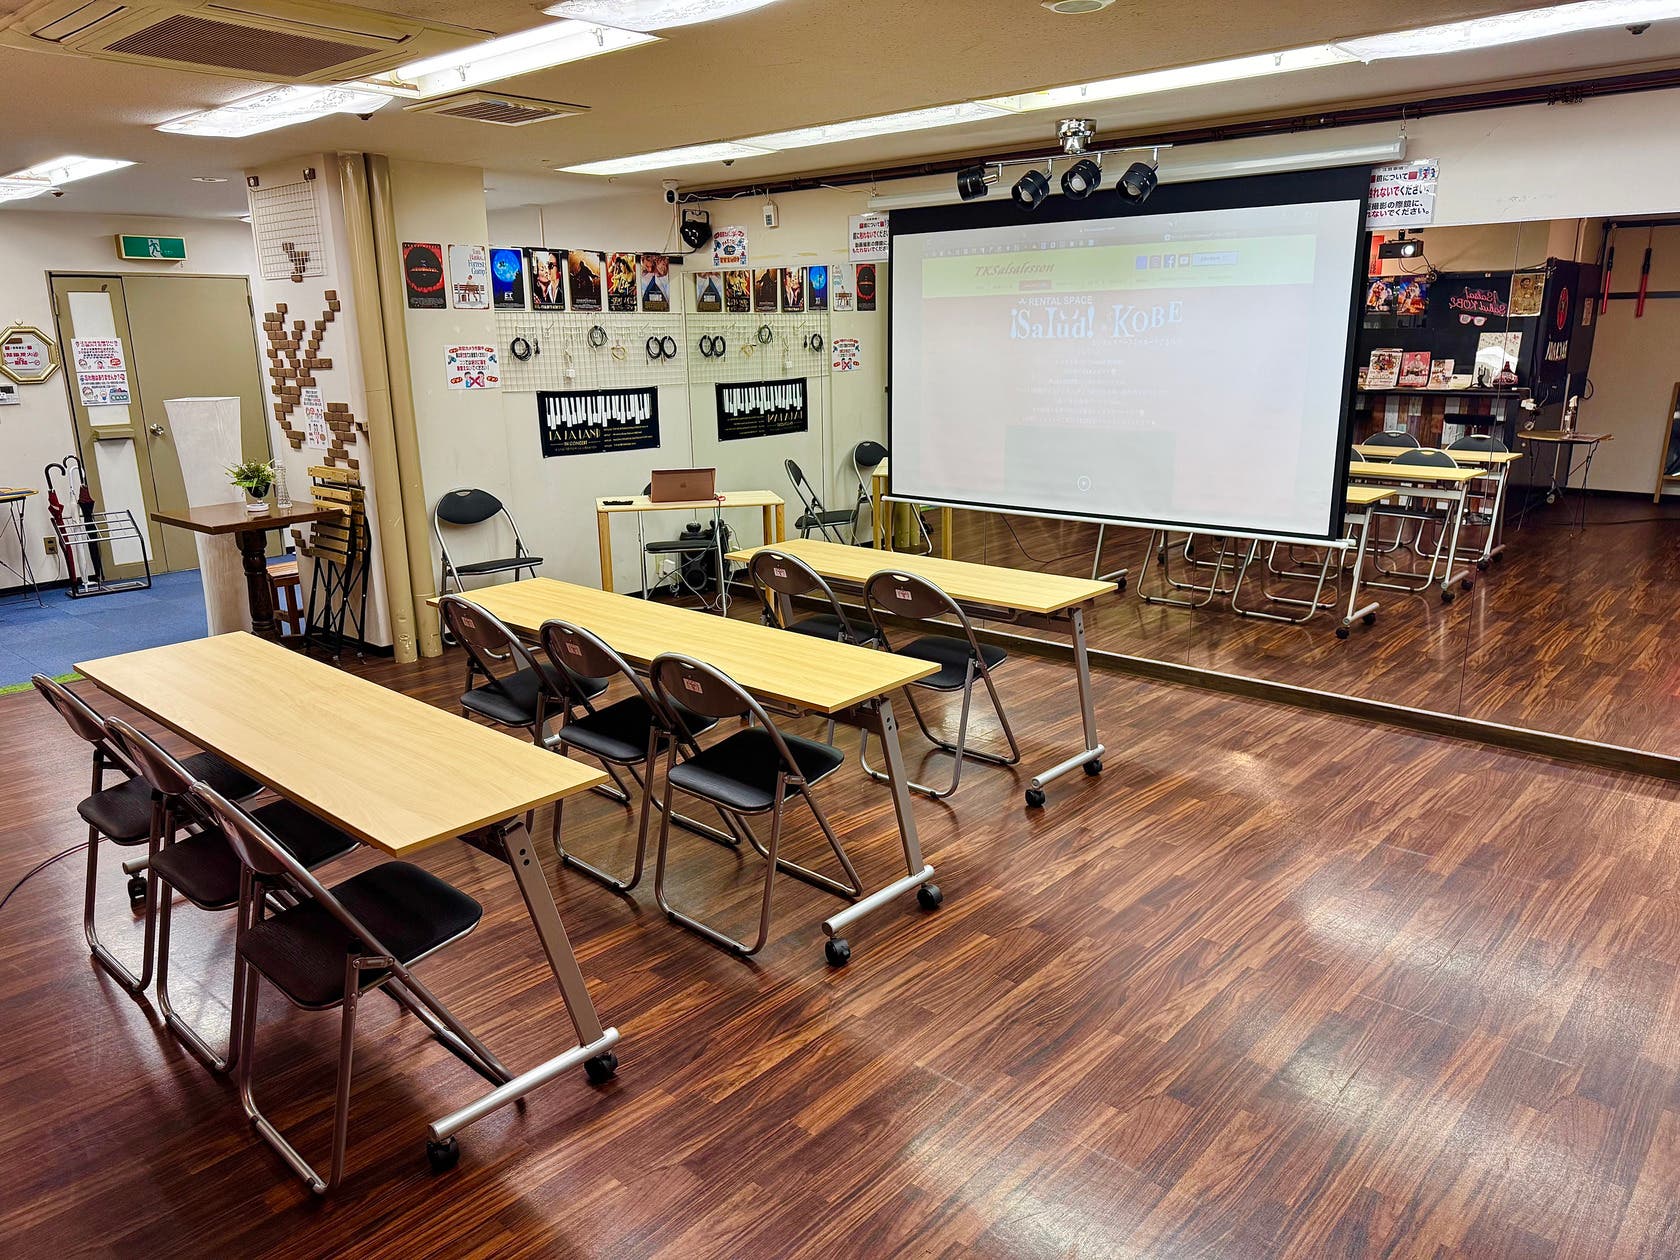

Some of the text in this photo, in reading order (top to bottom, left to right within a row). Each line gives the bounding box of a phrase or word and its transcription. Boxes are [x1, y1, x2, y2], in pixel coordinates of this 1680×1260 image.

[1029, 295, 1093, 306] RENTAL SPACE
[1112, 299, 1185, 338] KOBE
[549, 430, 562, 441] LA
[565, 430, 577, 440] LA
